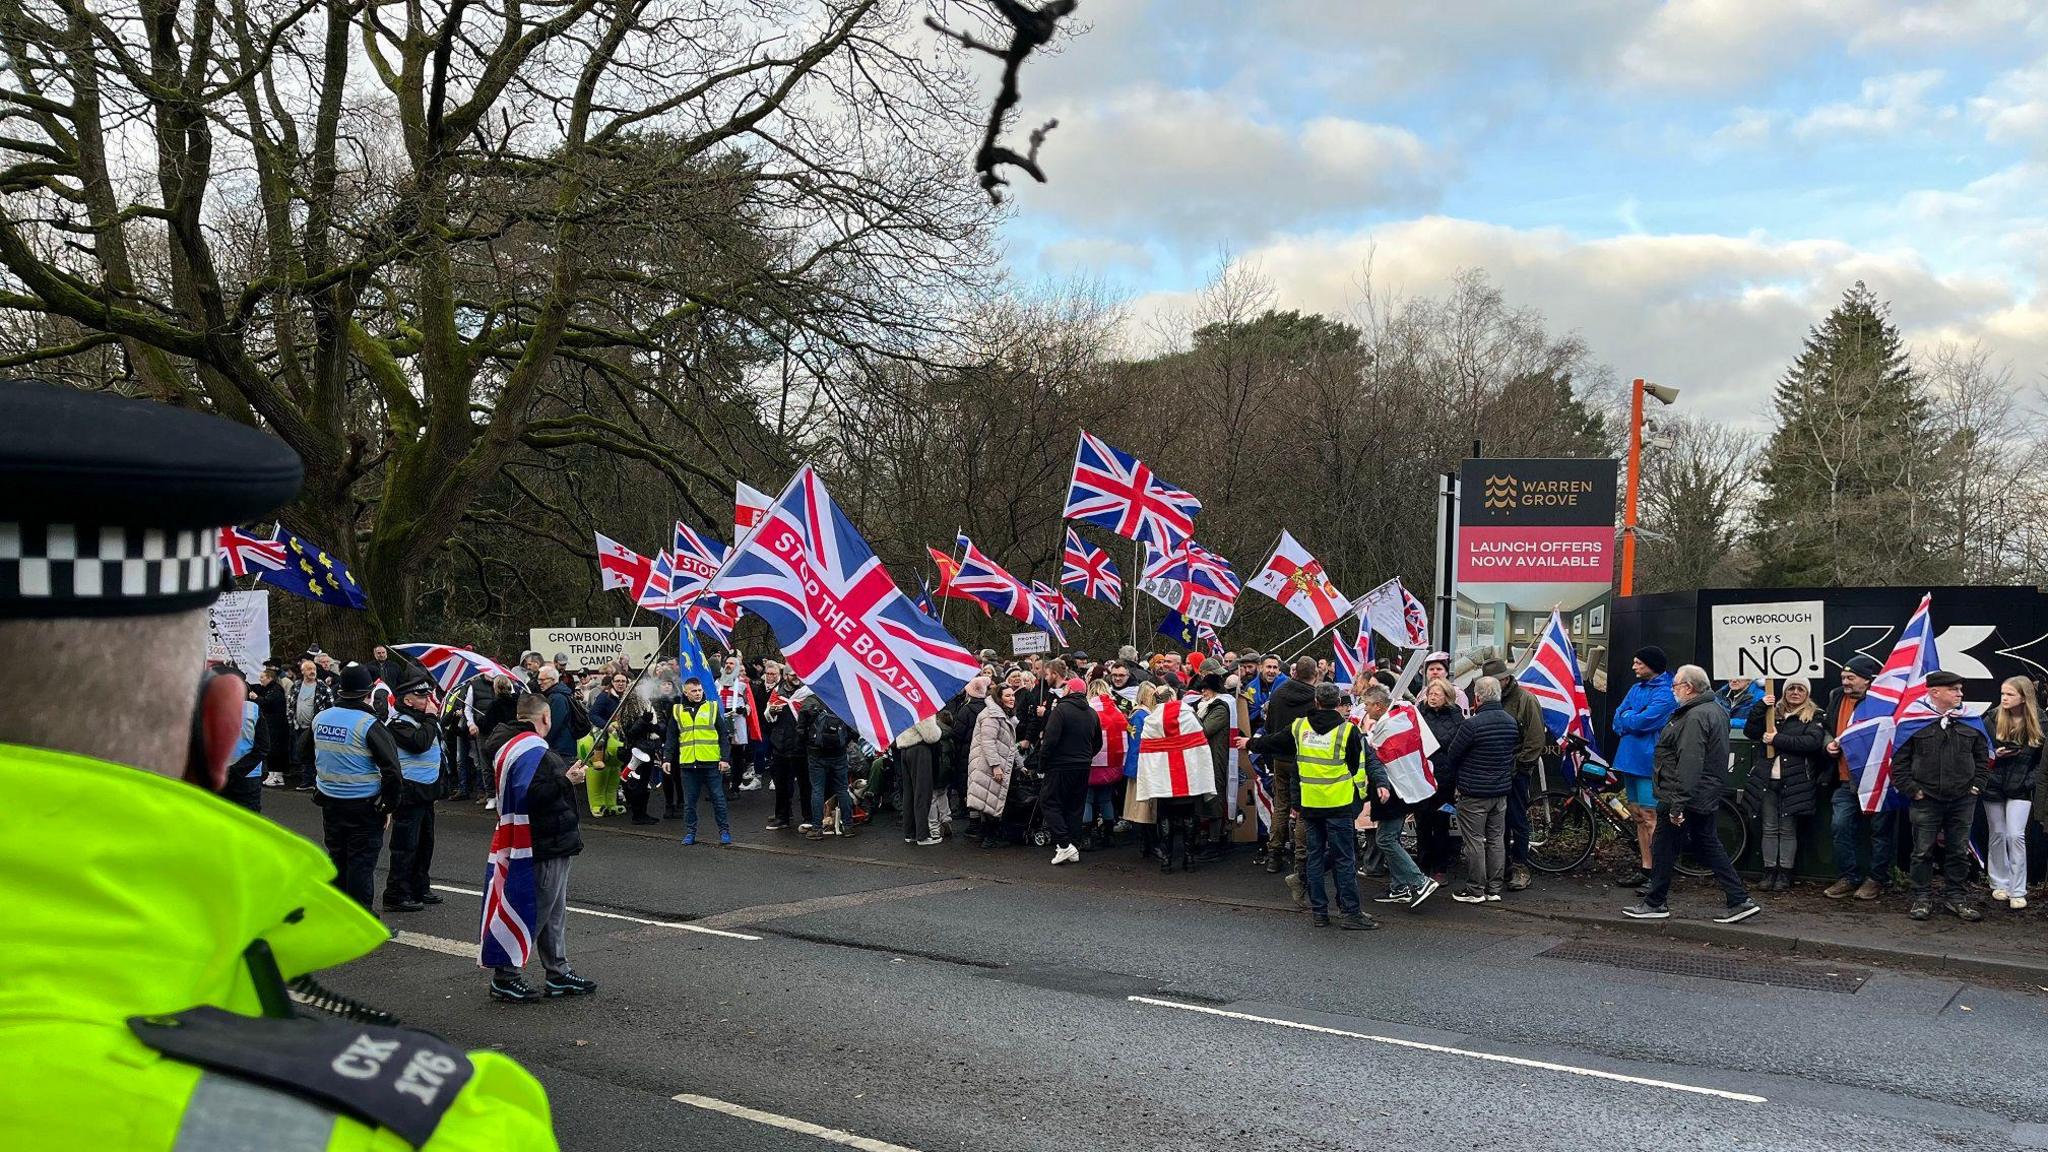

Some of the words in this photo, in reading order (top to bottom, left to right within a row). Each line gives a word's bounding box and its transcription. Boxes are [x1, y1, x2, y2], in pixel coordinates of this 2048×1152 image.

[1522, 481, 1592, 492] WARREN
[1522, 495, 1577, 506] GROVE
[1470, 542, 1537, 553] LAUNCH
[1540, 542, 1602, 553] OFFERS
[1471, 557, 1513, 567] NOW
[1516, 556, 1600, 567] AVAILABLE
[1187, 595, 1233, 625] MEN
[774, 532, 819, 596] STOP
[818, 595, 857, 640] THE
[851, 634, 922, 703] BOATS
[1722, 613, 1812, 625] CROWBOROUGH
[548, 631, 642, 642] CROWBOROUGH
[1750, 635, 1782, 645] SAYS
[569, 644, 623, 654] TRAINING
[580, 655, 614, 666] CAMP
[1739, 634, 1819, 677] NO!
[317, 725, 347, 737] POLICE
[331, 1033, 401, 1080] CK
[393, 1049, 457, 1106] 176
